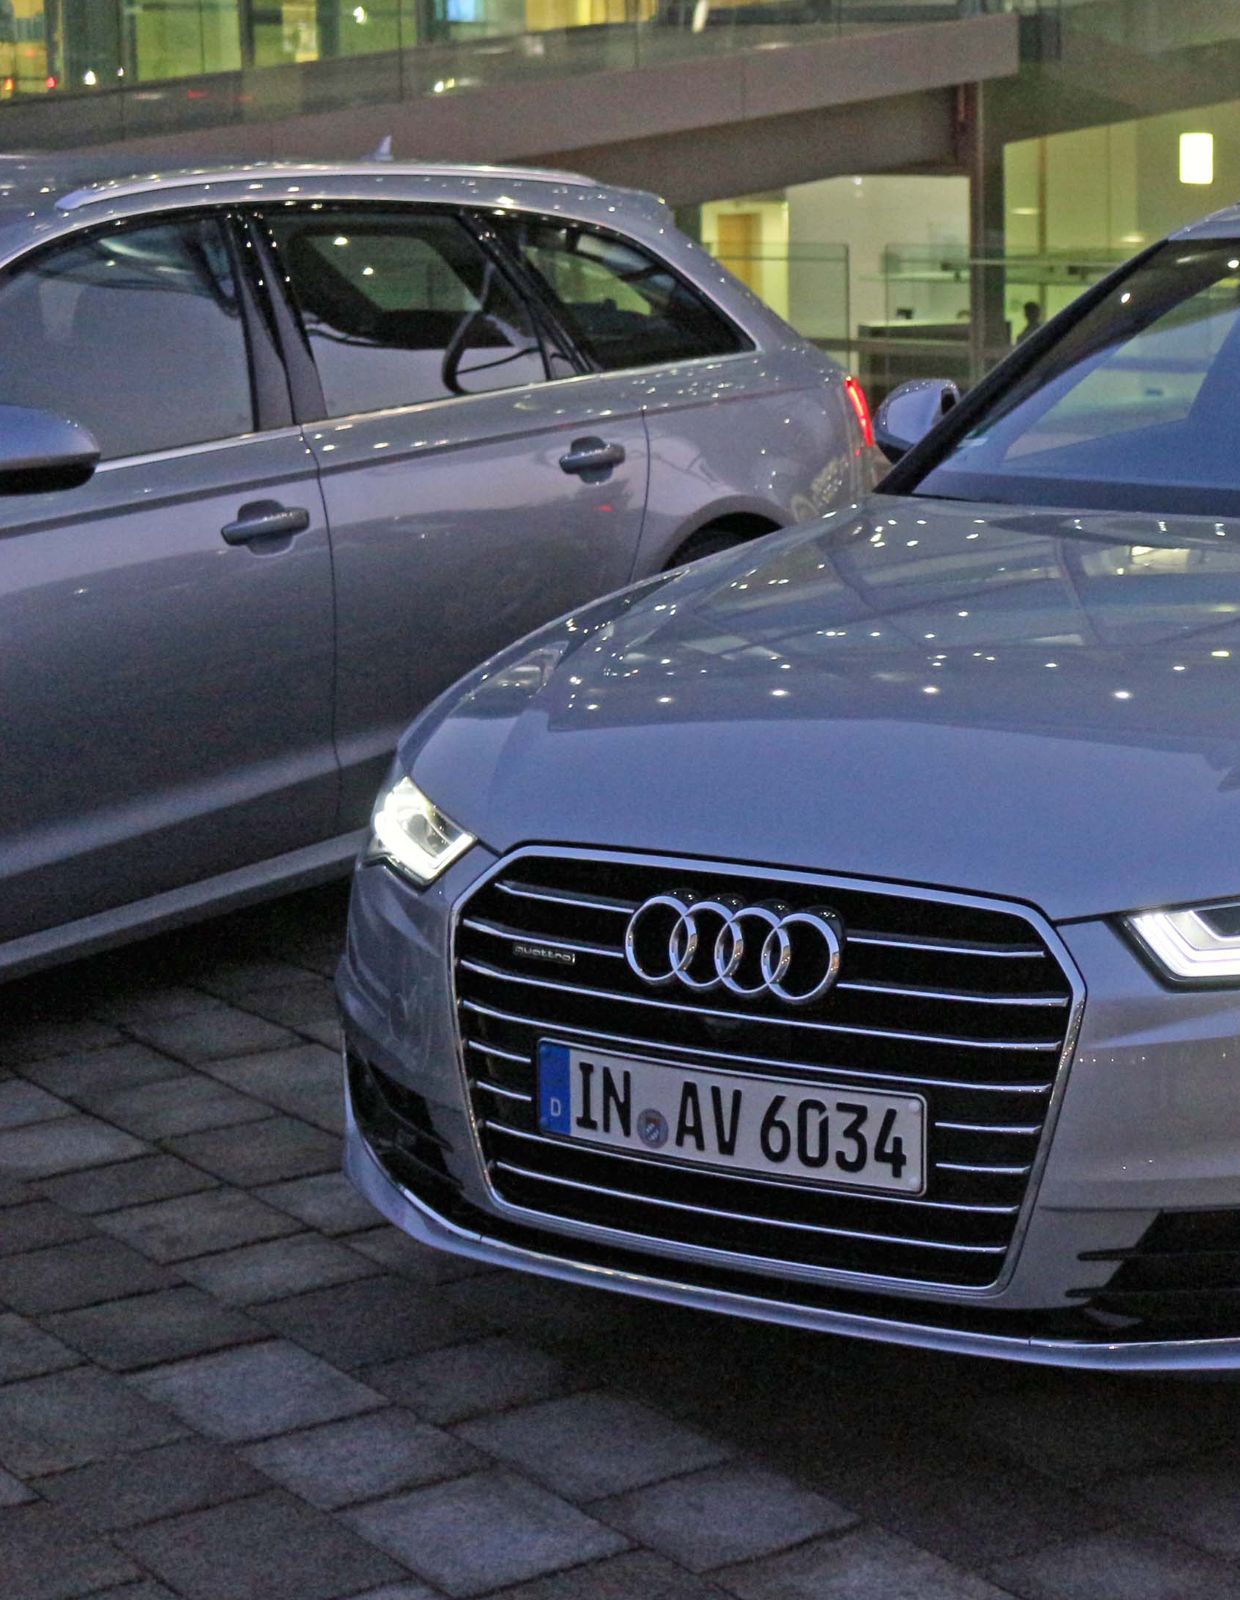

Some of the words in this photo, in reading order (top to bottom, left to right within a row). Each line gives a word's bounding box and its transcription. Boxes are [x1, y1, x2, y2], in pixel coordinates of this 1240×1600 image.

[514, 945, 572, 962] quattro
[549, 1097, 562, 1118] D
[576, 1062, 632, 1138] IN
[675, 1081, 742, 1156] AV
[760, 1095, 907, 1178] 6034
